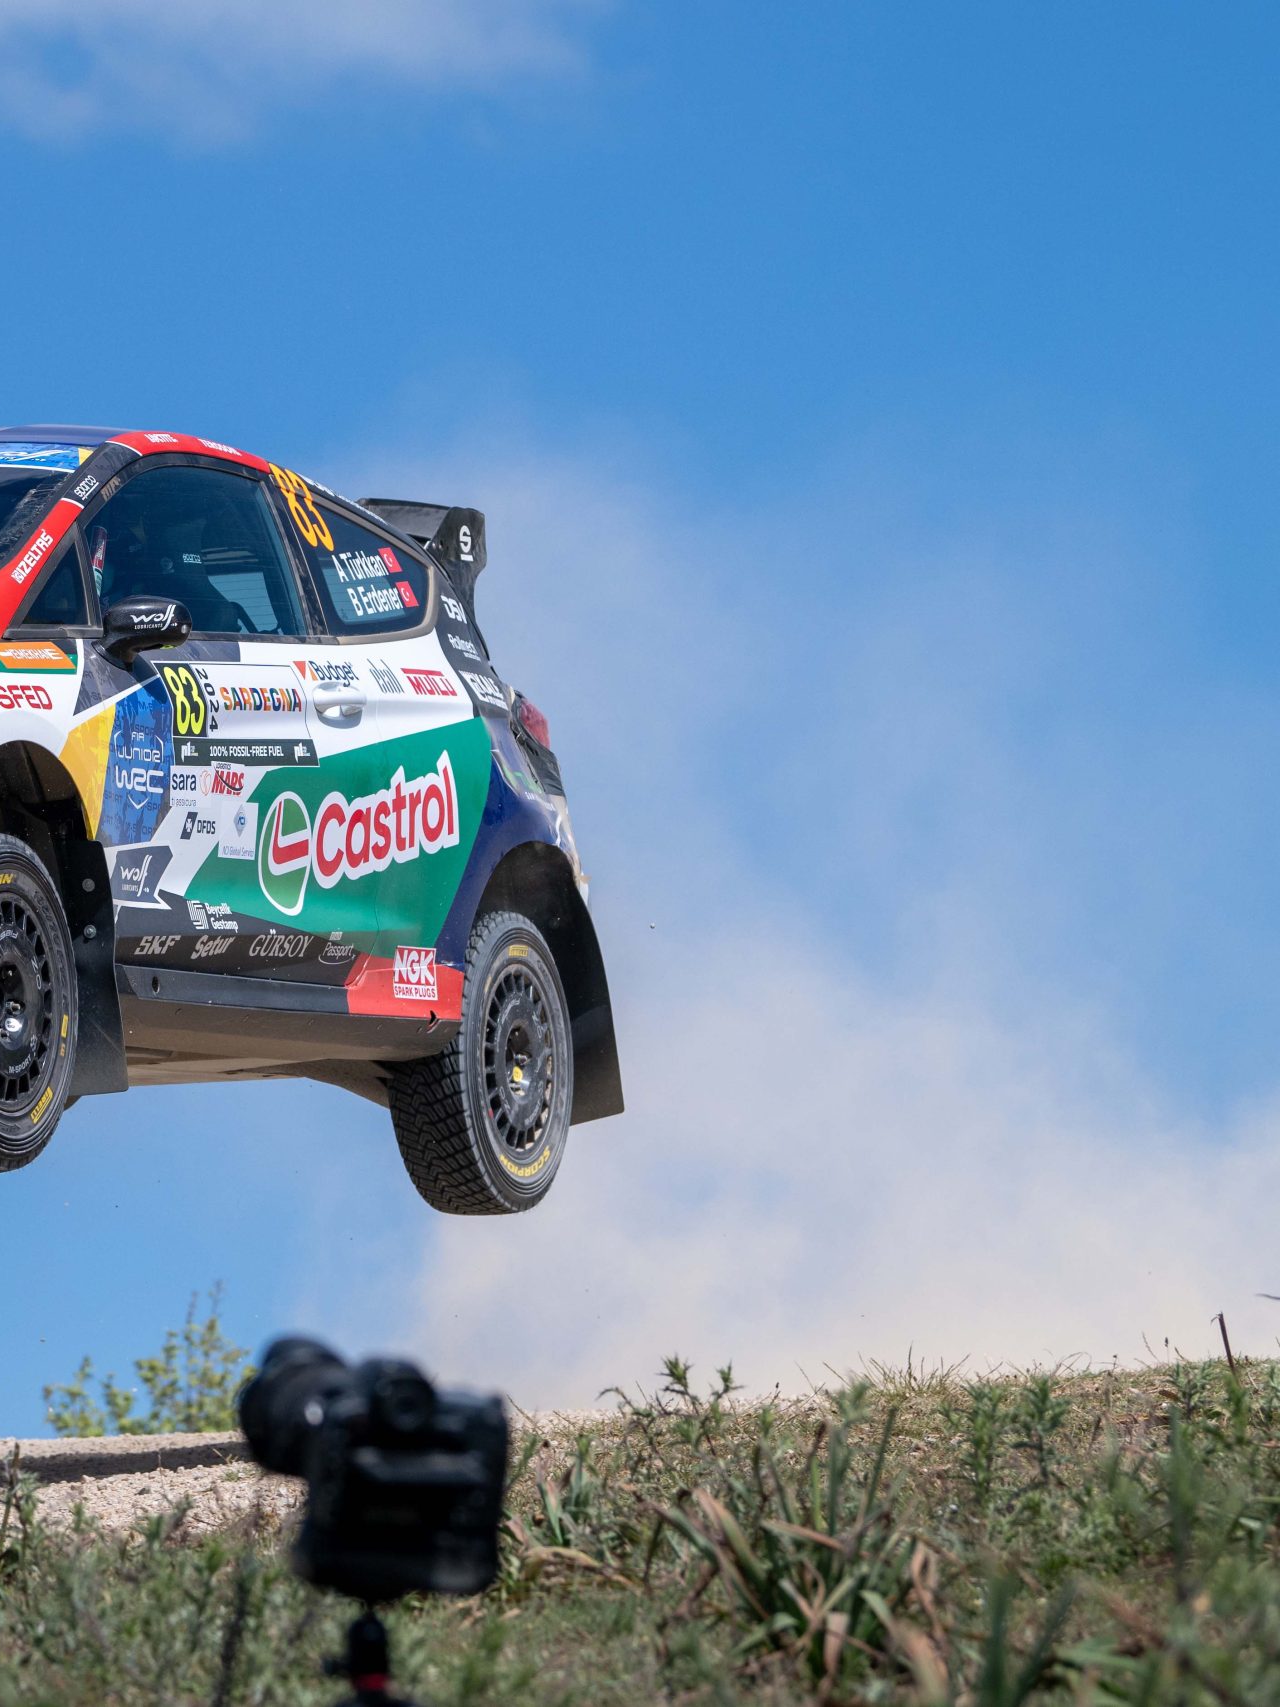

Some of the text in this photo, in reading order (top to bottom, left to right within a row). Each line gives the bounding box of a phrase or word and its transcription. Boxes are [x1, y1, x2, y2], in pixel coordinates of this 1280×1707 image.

[73, 474, 98, 498] sparco
[269, 462, 335, 552] 83
[331, 550, 389, 582] A Türkkan
[347, 584, 404, 616] B Erdener
[130, 605, 176, 631] wolf
[309, 660, 360, 688] Budget
[163, 666, 205, 735] 83
[195, 667, 220, 732] 2024
[219, 686, 302, 713] SARDEGNA
[131, 731, 145, 742] FIA
[117, 744, 161, 763] JUNIOR
[209, 745, 229, 757] 100%
[229, 745, 267, 758] FOSSIL-FREE
[268, 746, 285, 758] FUEL
[115, 765, 164, 794] WRC
[172, 773, 197, 791] sara
[196, 819, 216, 835] DFDS
[323, 764, 455, 877] Castrol
[134, 935, 182, 955] SKF
[190, 934, 237, 960] Setur
[248, 929, 315, 958] GÜRSOY
[323, 941, 354, 960] Passport
[394, 949, 435, 985] NGK
[394, 985, 436, 998] SPARK PLUGS
[8, 1053, 32, 1074] M-SPORT
